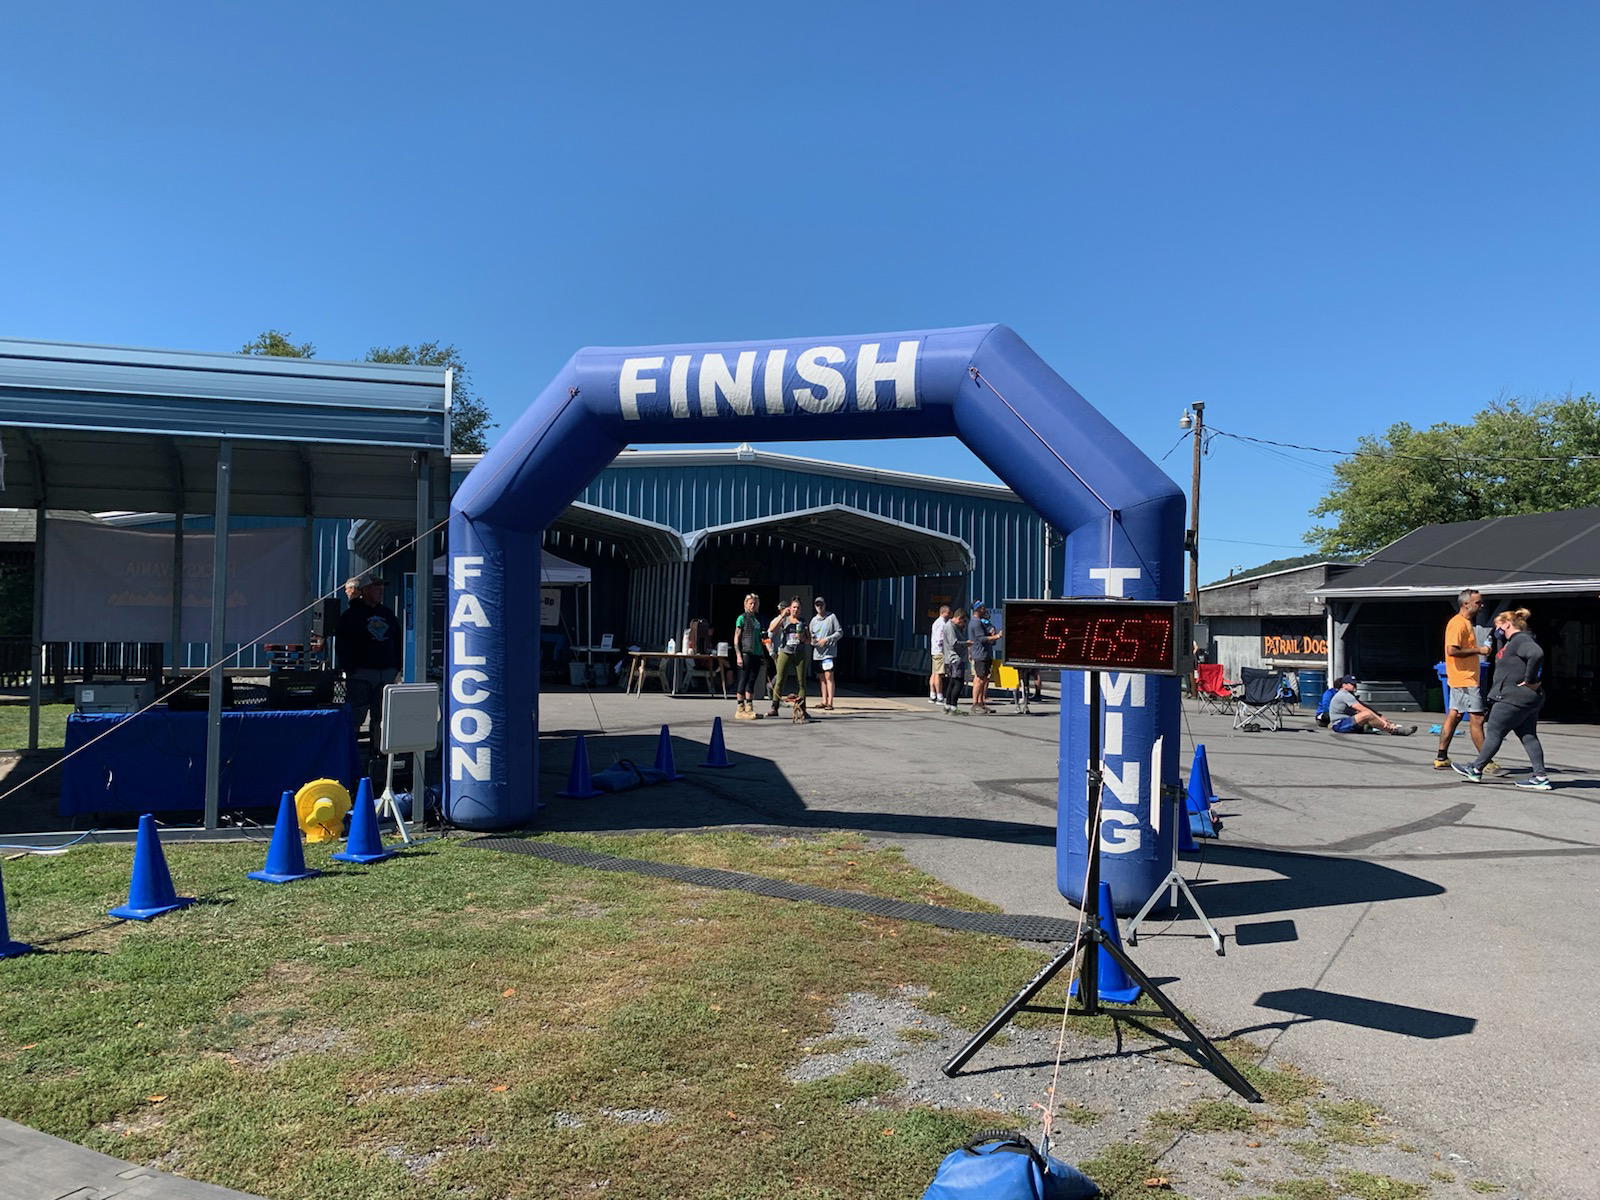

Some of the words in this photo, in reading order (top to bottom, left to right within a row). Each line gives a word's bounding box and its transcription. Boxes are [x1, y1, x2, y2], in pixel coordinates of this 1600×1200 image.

[619, 341, 920, 420] FINISH
[450, 556, 492, 781] FALCON
[1040, 617, 1171, 662] 5:16:57
[1083, 567, 1146, 854] TMING
